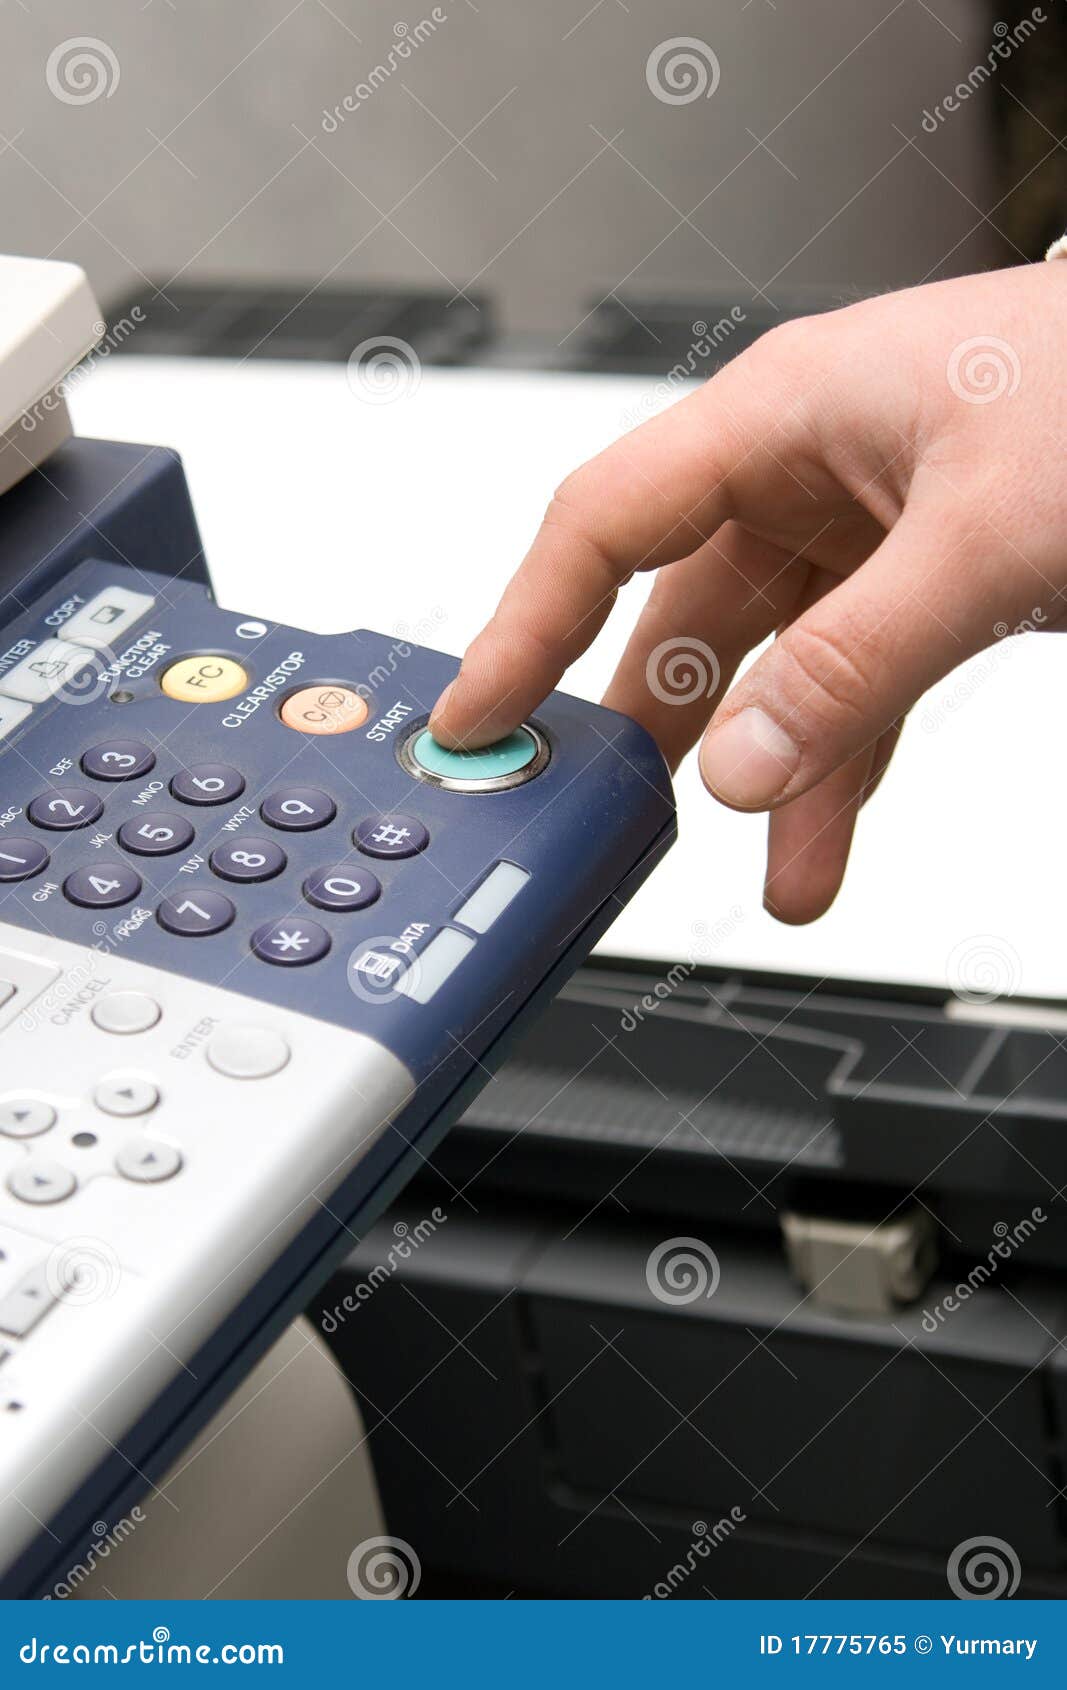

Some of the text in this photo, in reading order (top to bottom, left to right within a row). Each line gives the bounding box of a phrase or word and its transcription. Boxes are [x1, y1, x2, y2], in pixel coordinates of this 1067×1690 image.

[44, 594, 85, 627] COPY
[98, 631, 163, 682] FUNCTION
[126, 643, 172, 678] CLEAR
[186, 664, 224, 689] FC
[222, 651, 307, 729] CLEAR/STOP
[366, 701, 414, 742] START
[49, 757, 73, 777] DEF
[101, 751, 136, 768] 3
[132, 781, 164, 806] MNO
[192, 777, 225, 792] 6
[0, 806, 23, 828] ABC
[48, 799, 85, 817] 2
[280, 799, 315, 815] 9
[221, 806, 256, 832] WXYZ
[88, 831, 113, 849] JKL
[138, 824, 174, 842] 5
[179, 854, 205, 875] TUV
[230, 851, 266, 867] 8
[32, 882, 59, 902] GHI
[88, 875, 121, 895] 4
[176, 901, 211, 920] 7
[390, 922, 431, 954] DATA
[51, 978, 112, 1026] CANCEL
[170, 1015, 220, 1060] ENTER
